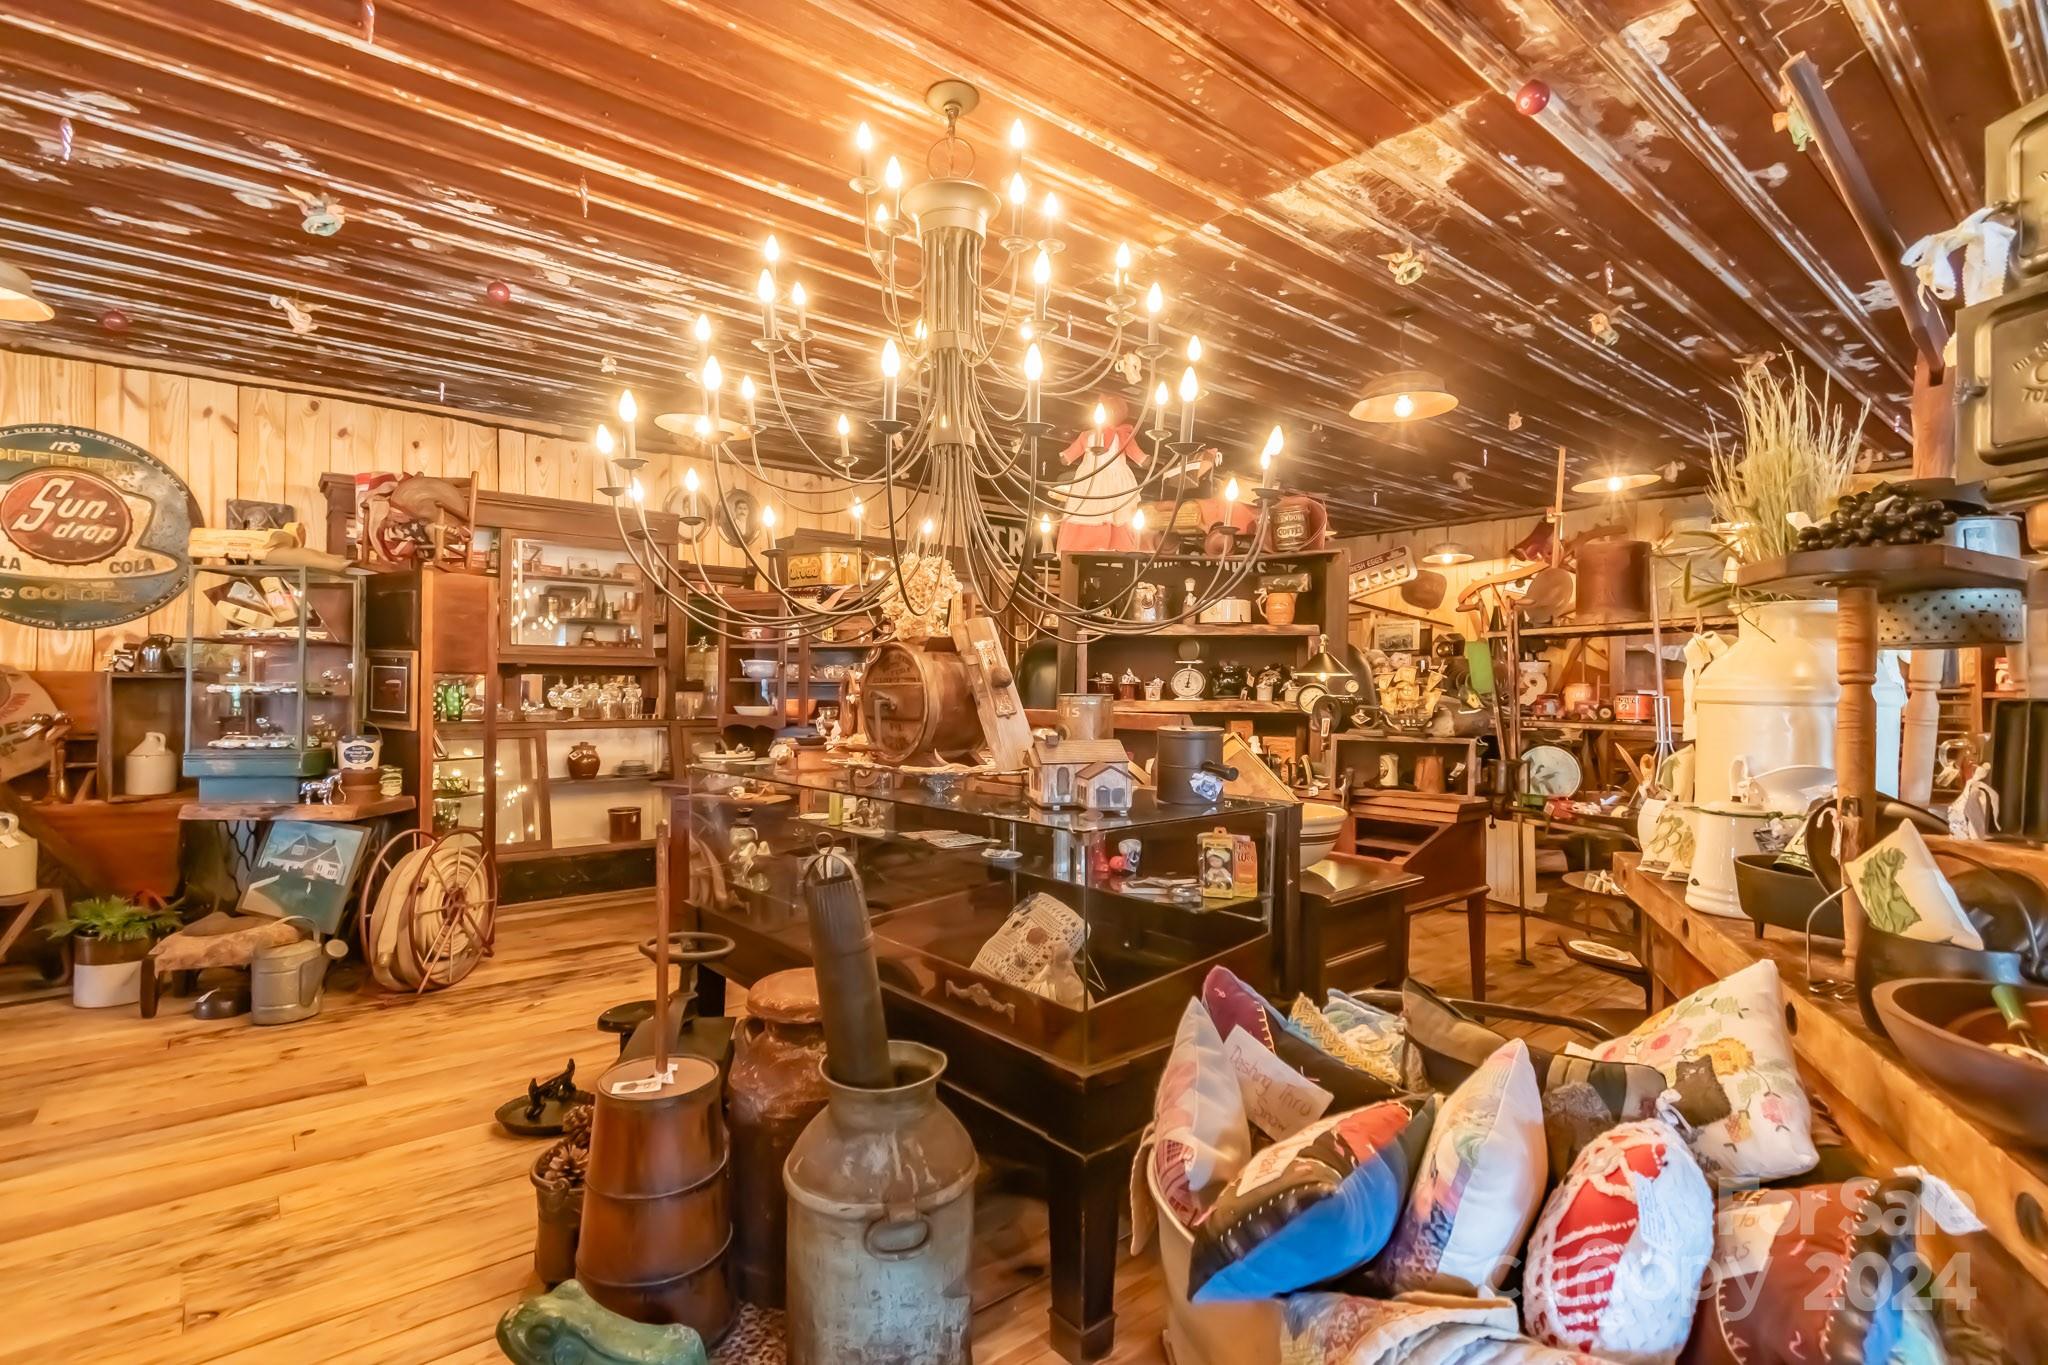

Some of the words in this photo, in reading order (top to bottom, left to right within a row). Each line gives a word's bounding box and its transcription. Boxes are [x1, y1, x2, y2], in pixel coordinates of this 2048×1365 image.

[49, 441, 81, 453] IT'S
[52, 522, 117, 543] drop
[109, 558, 156, 574] COLA
[1366, 556, 1384, 567] EGGS
